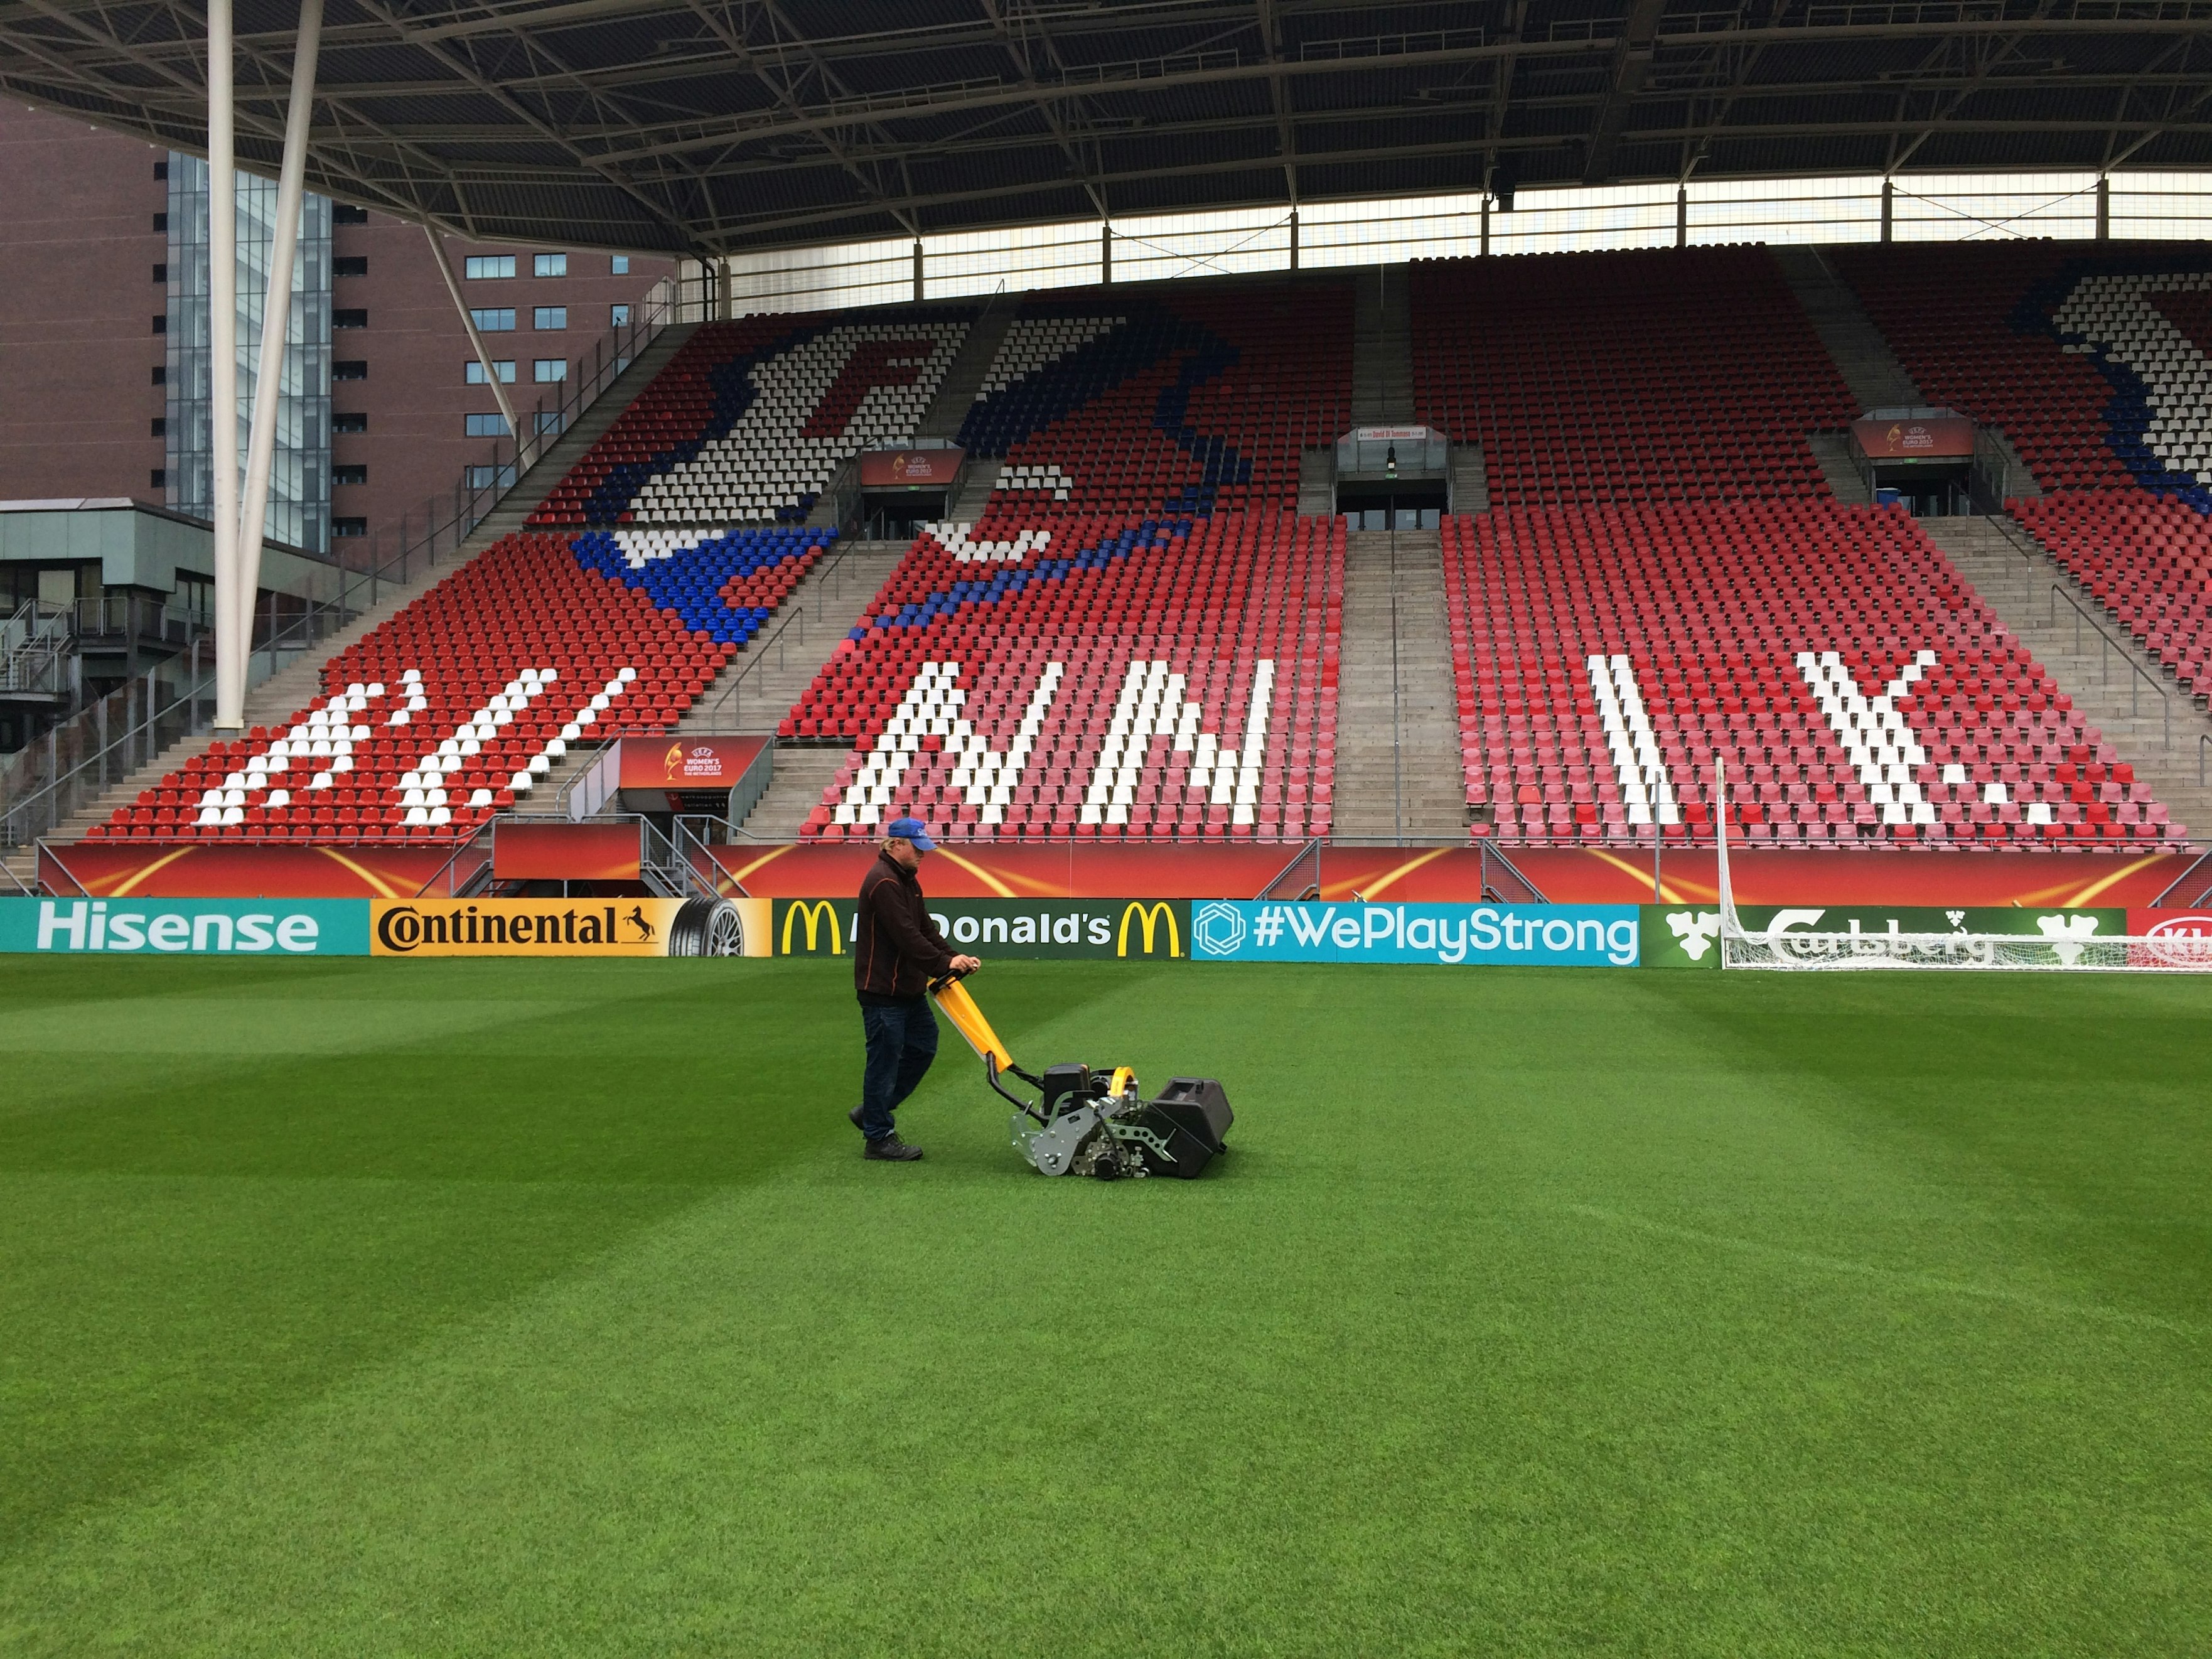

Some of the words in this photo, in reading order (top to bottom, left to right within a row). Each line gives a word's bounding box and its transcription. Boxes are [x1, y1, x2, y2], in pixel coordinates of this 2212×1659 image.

[692, 747, 714, 758] UEFA
[36, 901, 319, 952] Hisense
[377, 906, 616, 952] Continental
[849, 913, 1111, 945] Donald's
[1253, 906, 1638, 965] #WePlayStrong
[2163, 928, 2212, 954] KI
